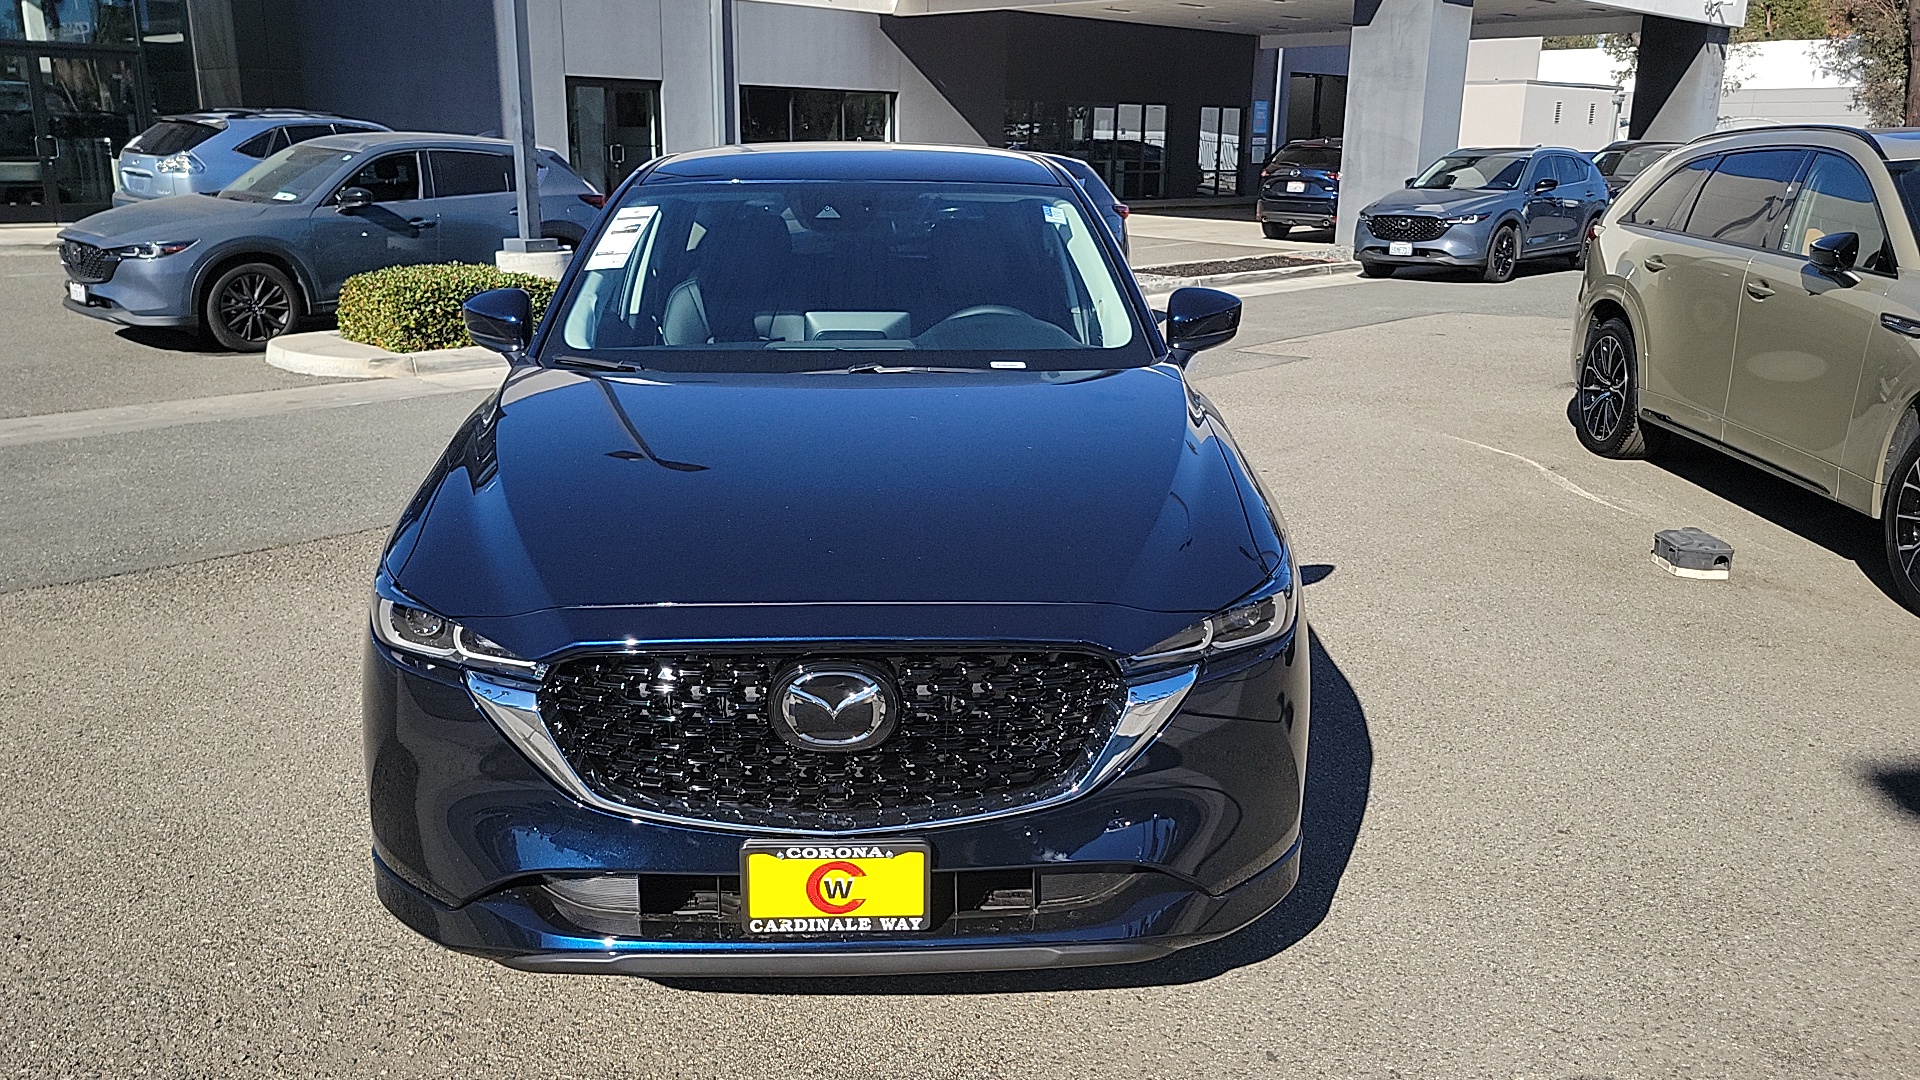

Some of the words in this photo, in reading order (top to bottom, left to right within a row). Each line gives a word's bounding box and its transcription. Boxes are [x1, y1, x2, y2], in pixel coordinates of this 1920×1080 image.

[785, 846, 885, 859] CORONA
[749, 917, 872, 933] CARDINALE
[879, 917, 924, 931] WAY
